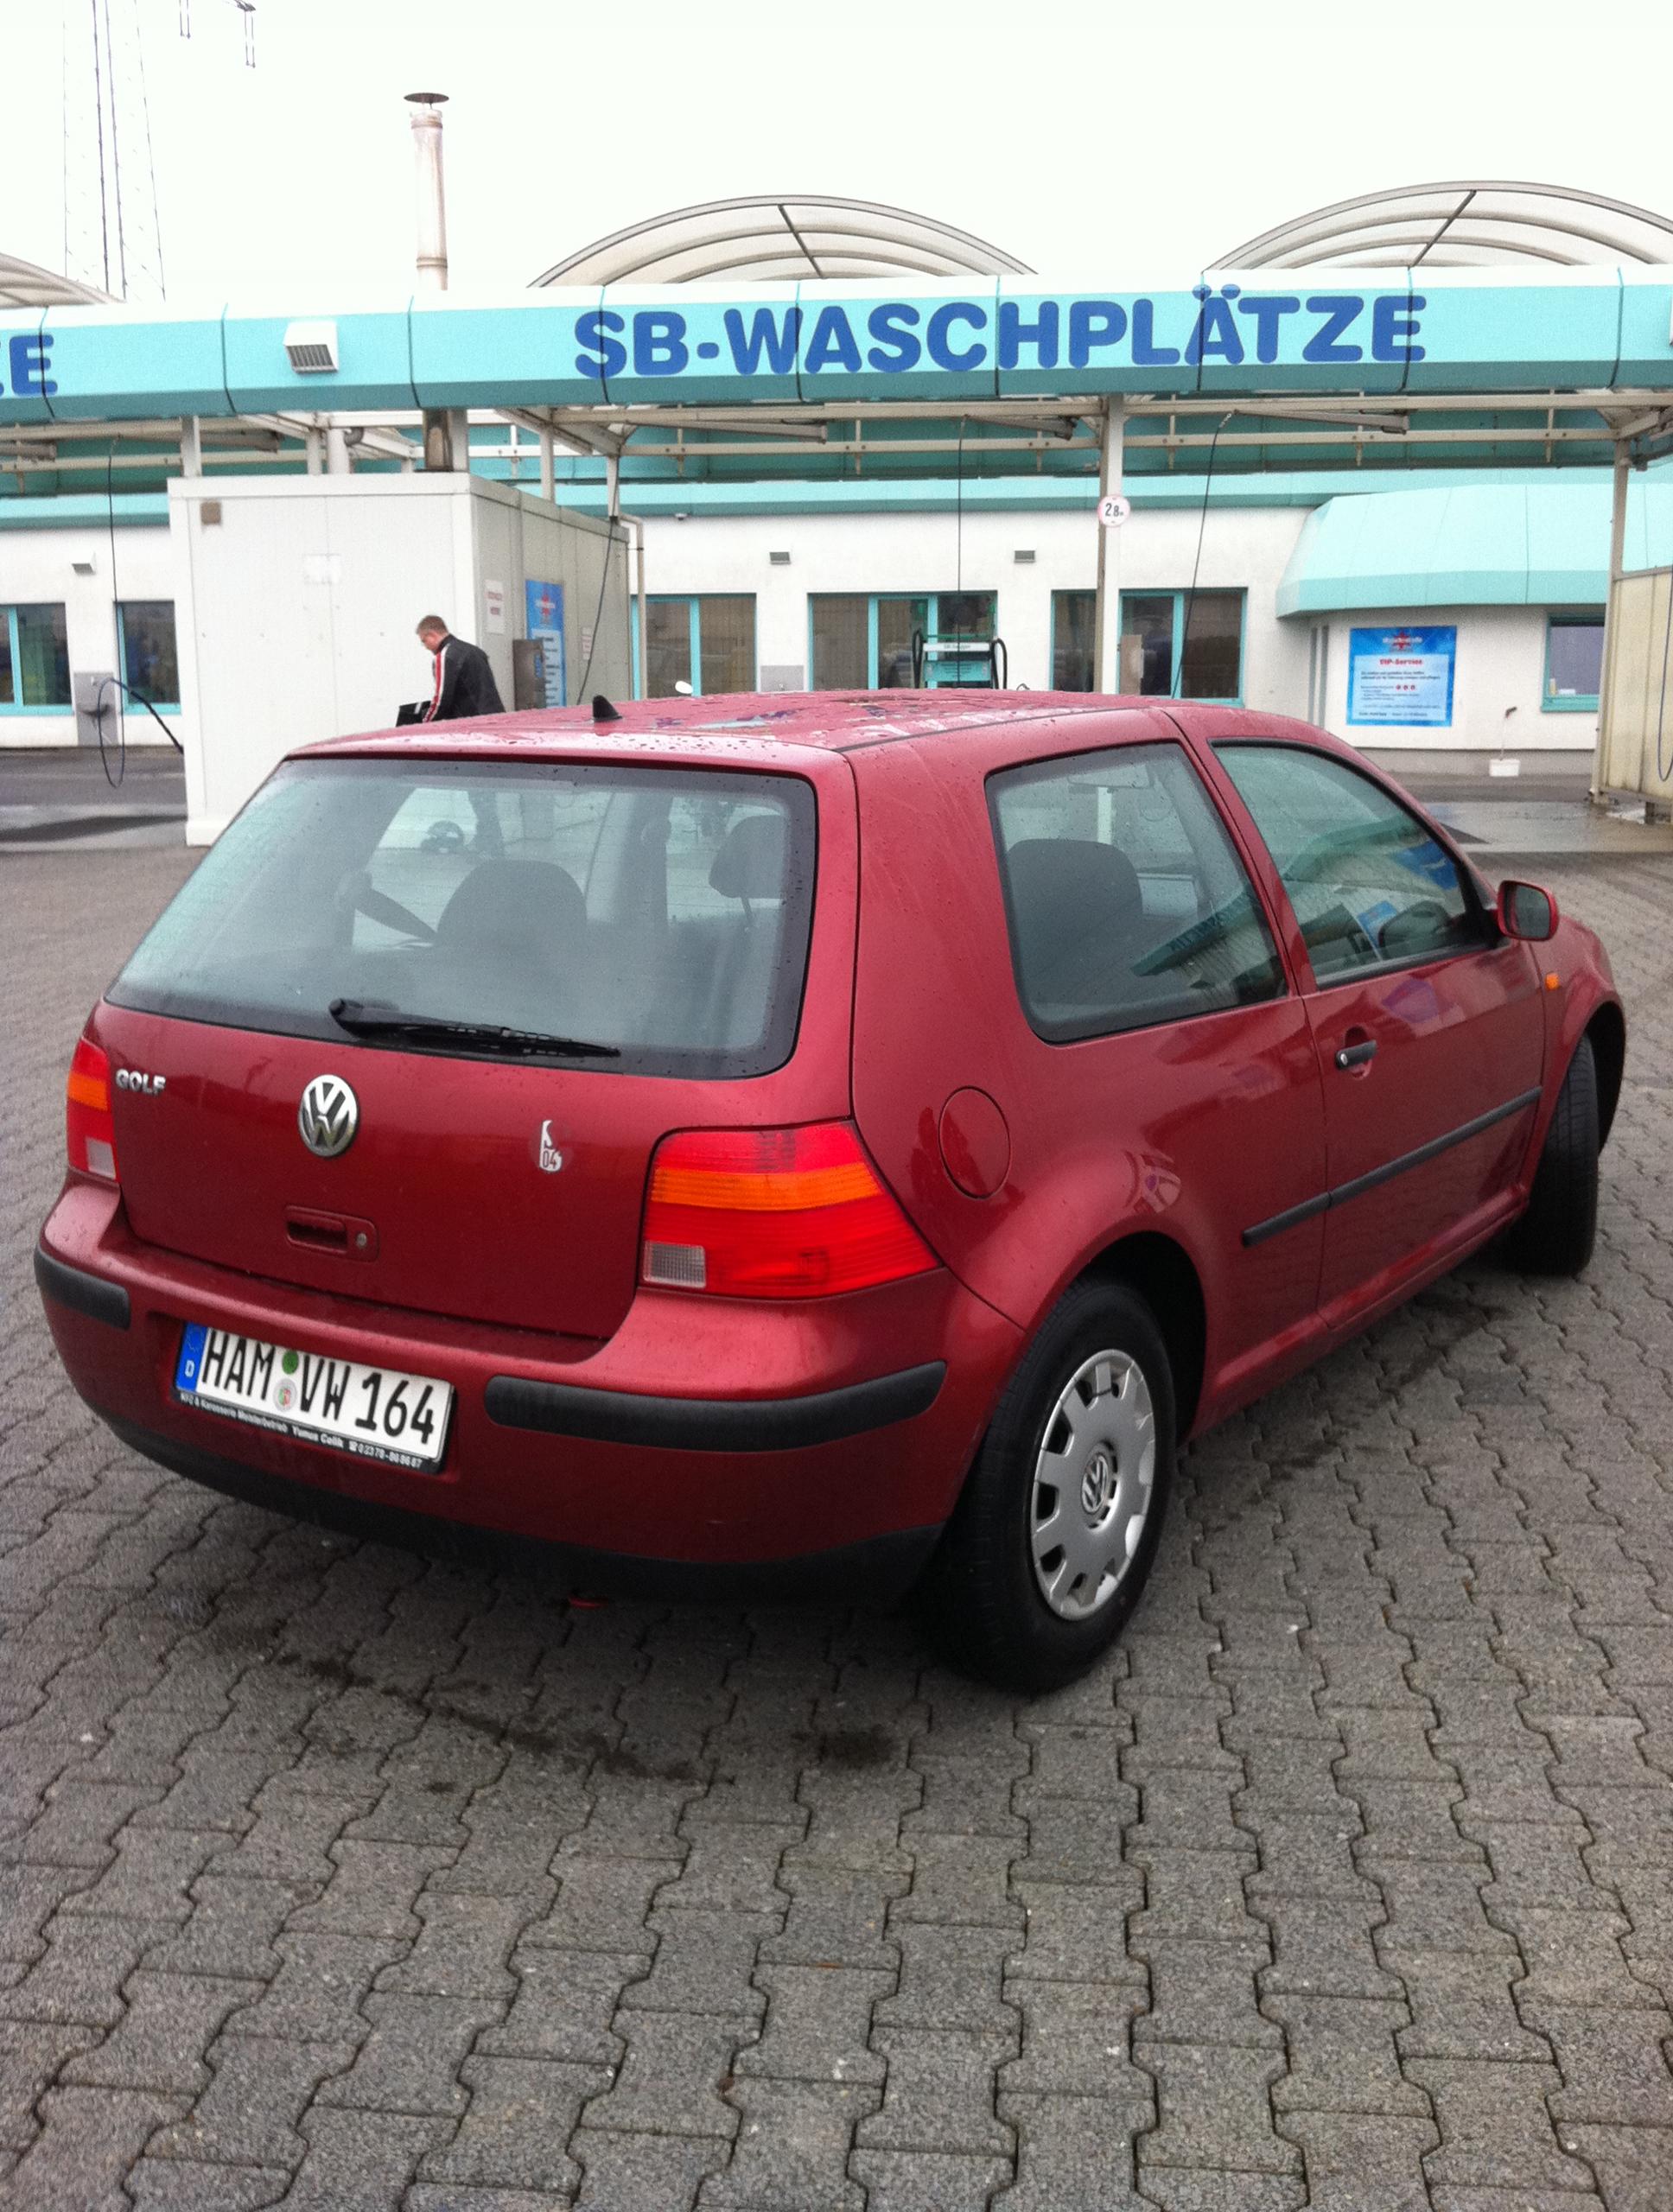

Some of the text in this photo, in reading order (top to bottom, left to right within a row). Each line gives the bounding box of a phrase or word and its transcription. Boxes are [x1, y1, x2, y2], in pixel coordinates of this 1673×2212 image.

[575, 285, 1426, 378] SB-WASCHPLÄTZE
[0, 334, 58, 395] E
[116, 1069, 166, 1096] GOLF
[184, 1359, 195, 1378] D
[201, 1329, 434, 1445] HAM VW 164
